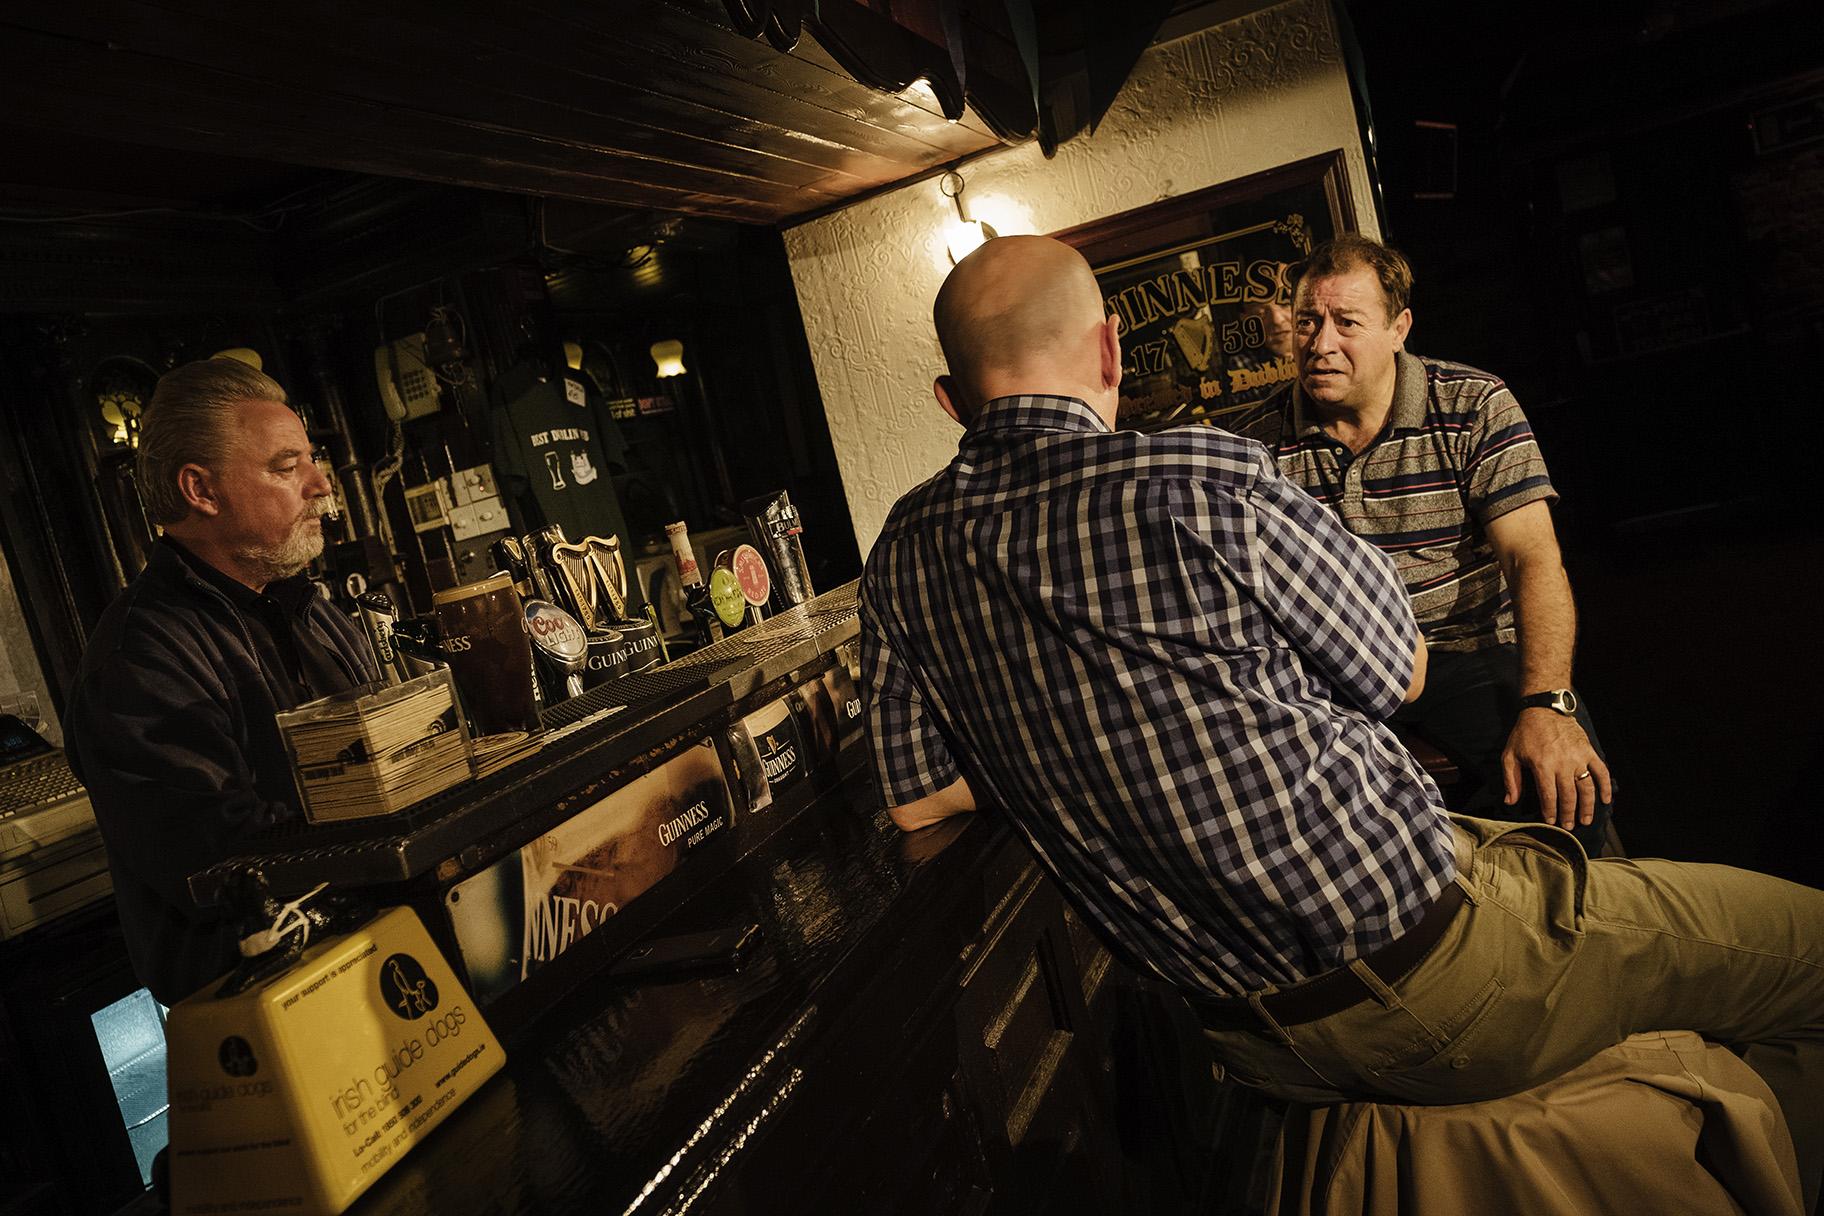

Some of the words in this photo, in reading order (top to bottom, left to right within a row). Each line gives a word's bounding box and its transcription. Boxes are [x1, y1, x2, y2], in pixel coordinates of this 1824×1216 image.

[1131, 339, 1168, 376] 17
[1222, 315, 1266, 354] 59
[657, 800, 710, 848] GUINNESS
[687, 828, 705, 848] PURE
[704, 815, 725, 838] MAGIC
[281, 993, 299, 1010] your
[301, 974, 331, 999] support
[337, 944, 378, 976] appreciated
[330, 1077, 372, 1121] irish
[374, 1037, 424, 1093] guide
[425, 1005, 466, 1050] dogs
[435, 1043, 486, 1088] www.guidedogs.ie
[343, 1118, 358, 1137] for
[358, 1103, 377, 1126] the
[408, 1086, 457, 1137] independence
